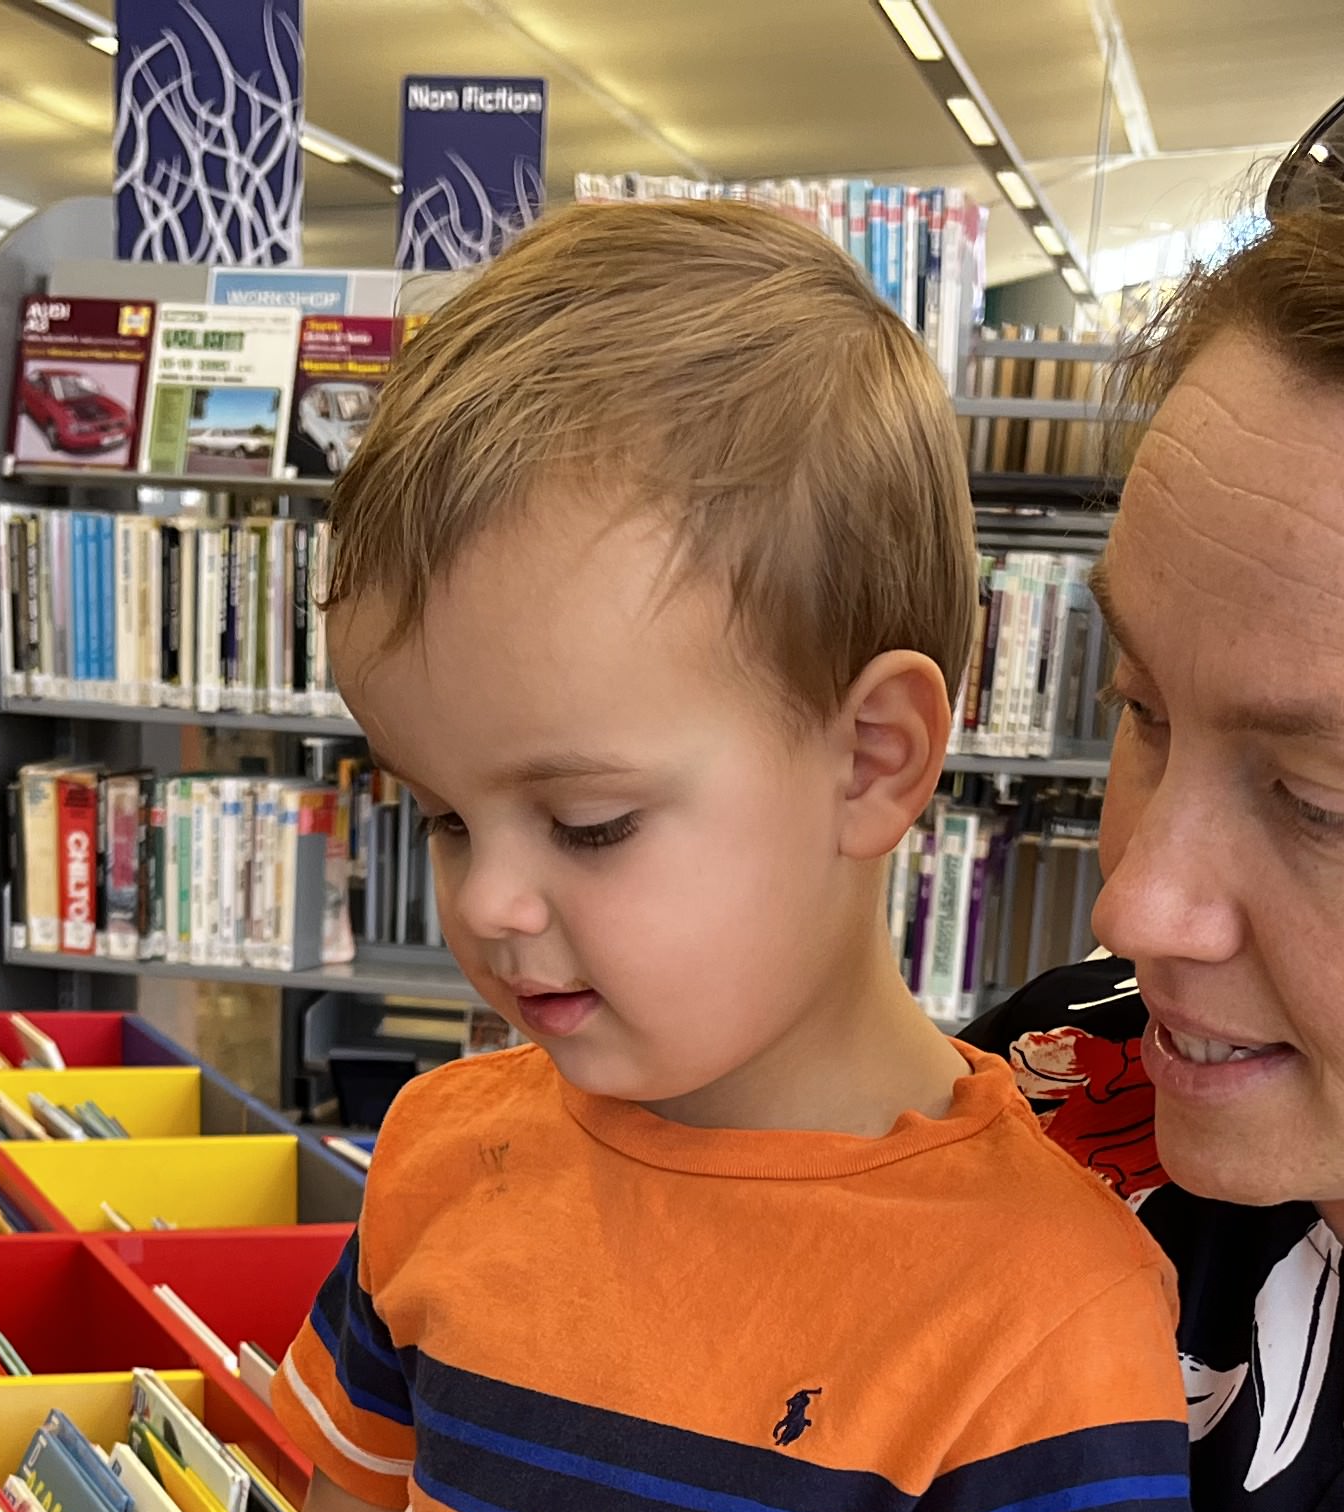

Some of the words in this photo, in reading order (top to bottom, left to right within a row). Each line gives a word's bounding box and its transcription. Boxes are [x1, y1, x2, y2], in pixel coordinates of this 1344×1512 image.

[408, 85, 459, 111] Non
[462, 86, 542, 113] Fiction
[26, 302, 71, 320] AUDI
[227, 289, 341, 310] WORKSHOP
[66, 830, 91, 922] CHILTO
